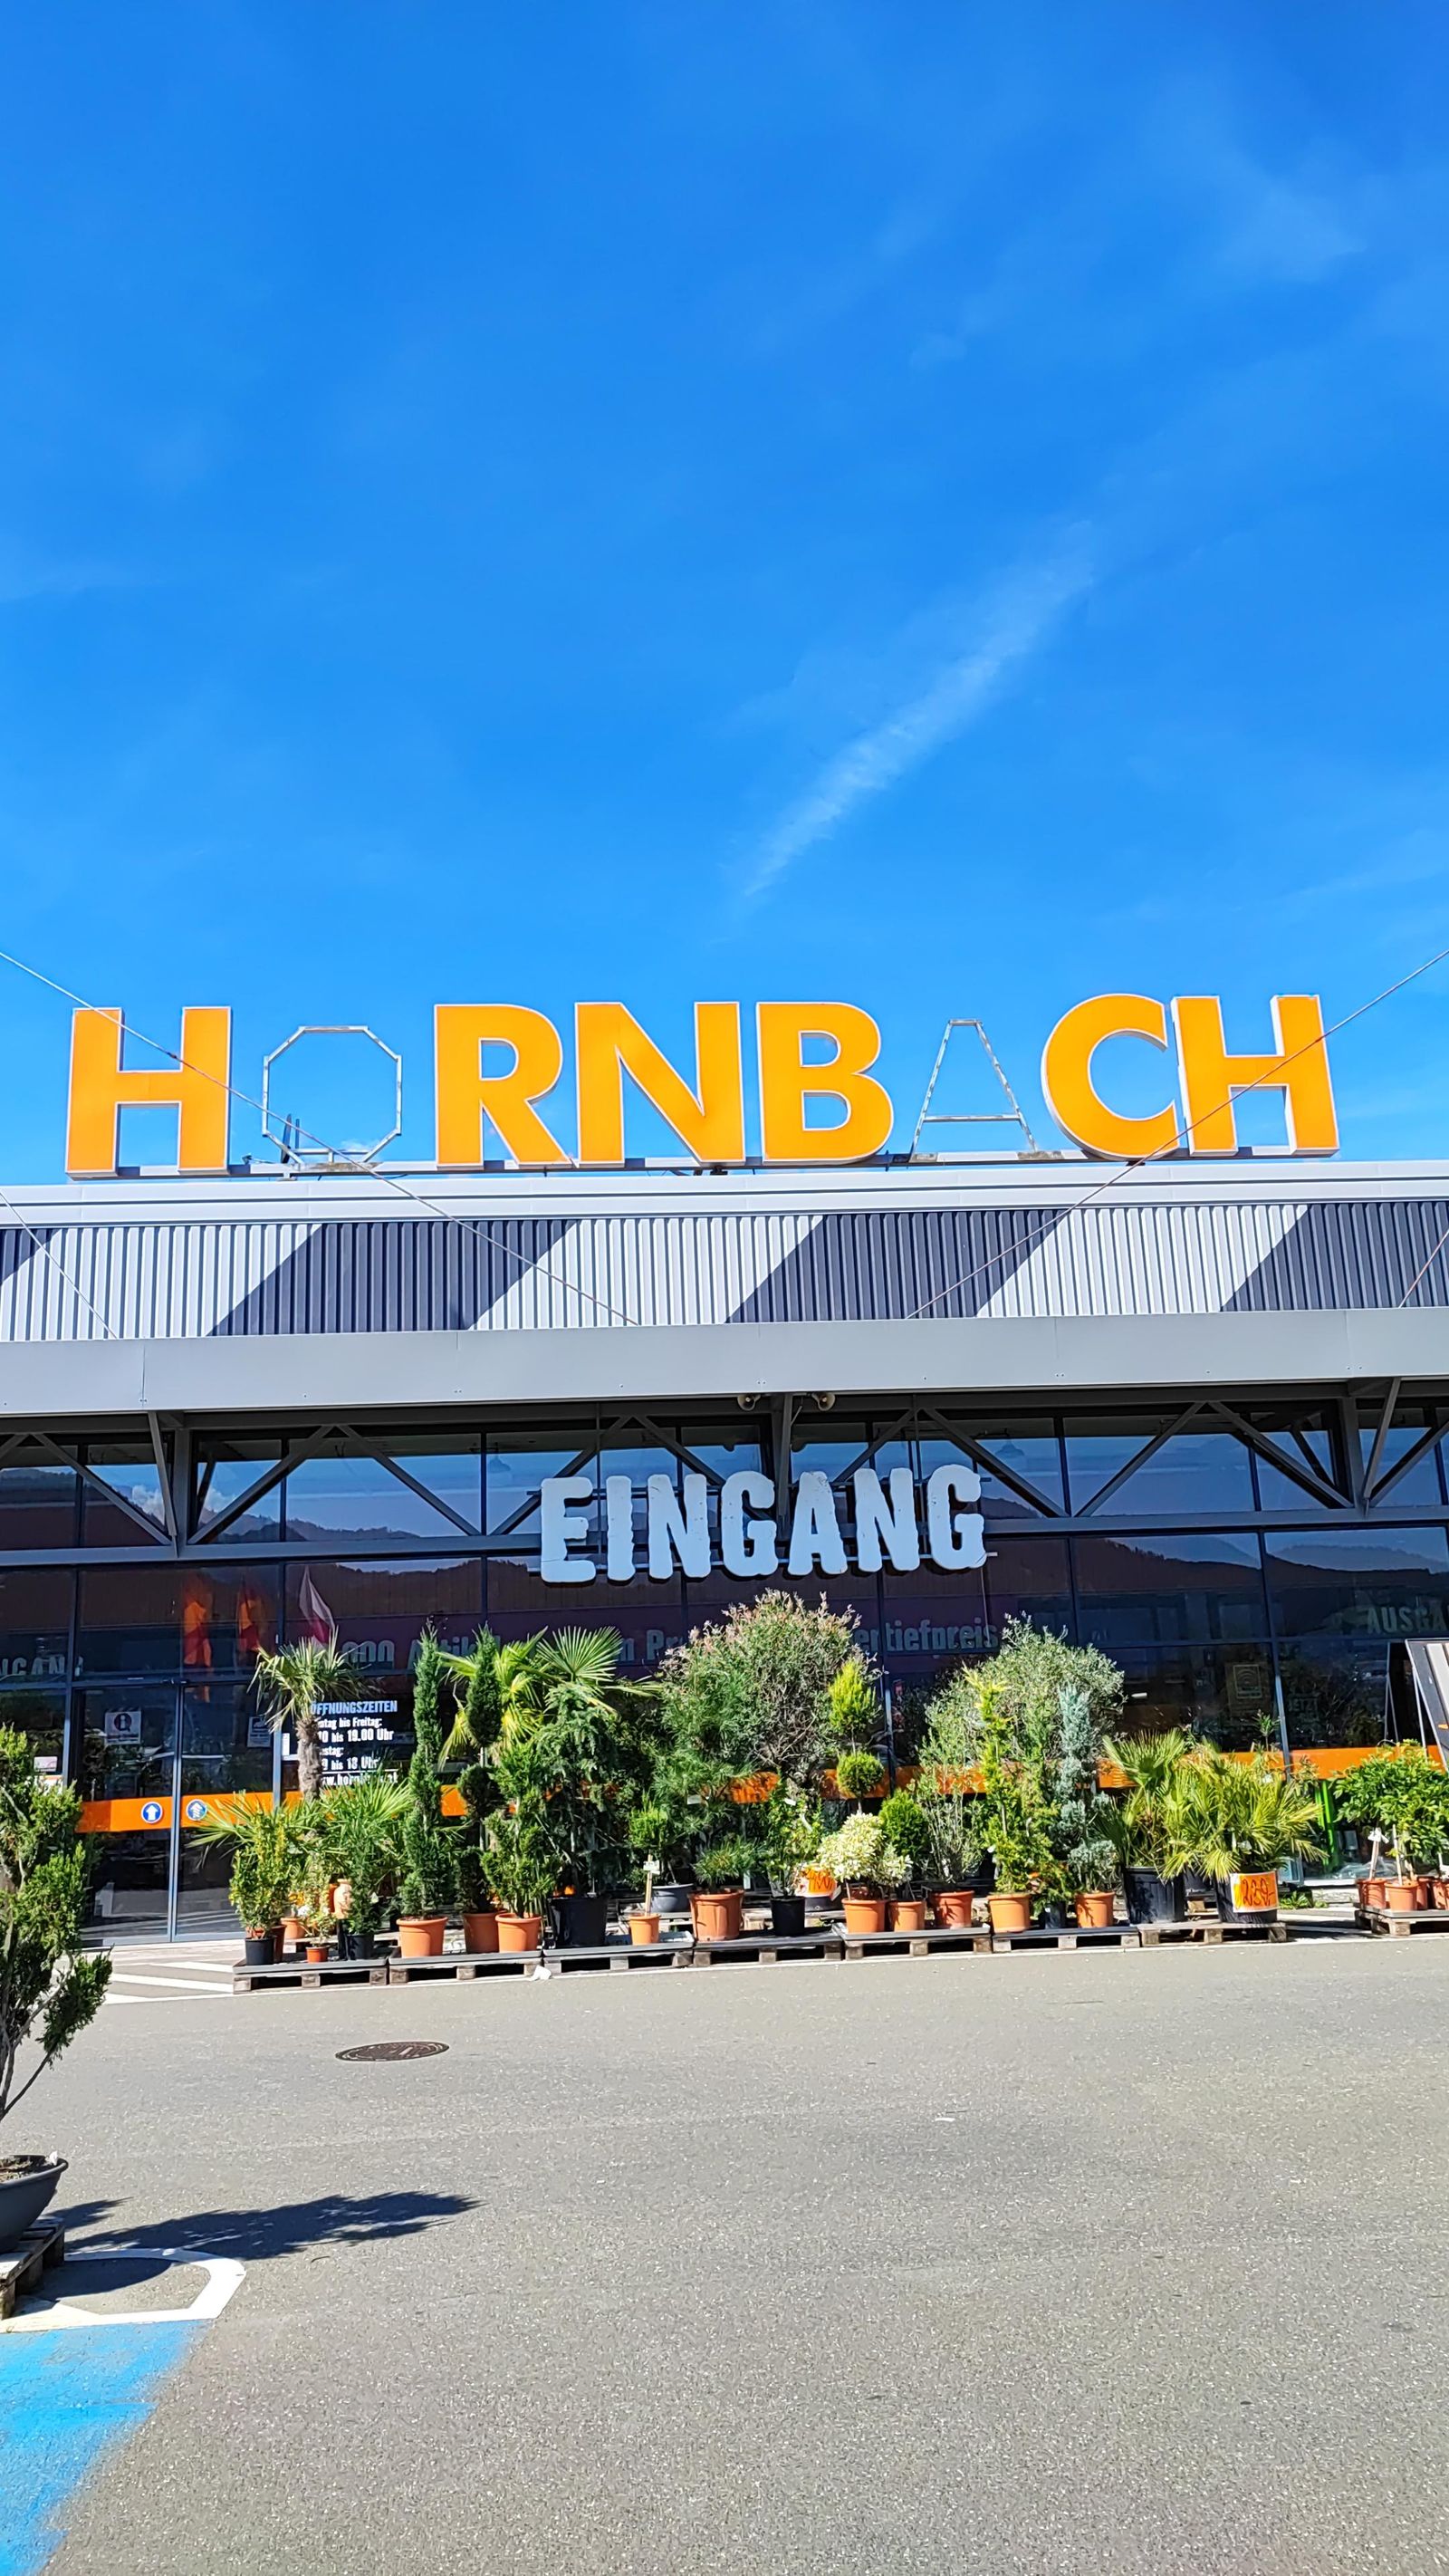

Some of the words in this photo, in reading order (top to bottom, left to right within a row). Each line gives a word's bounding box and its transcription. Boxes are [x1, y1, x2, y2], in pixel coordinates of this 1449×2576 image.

[64, 993, 1340, 1178] HORNBACH
[541, 1464, 987, 1582] EINGANG
[1367, 1605, 1449, 1634] AUSGA
[339, 1717, 351, 1727] bis
[352, 1716, 382, 1729] Freitag:
[331, 1732, 344, 1743] bis
[347, 1728, 374, 1742] 19.00
[376, 1728, 395, 1741] Uhr
[331, 1760, 343, 1771] bis
[346, 1756, 359, 1770] 18
